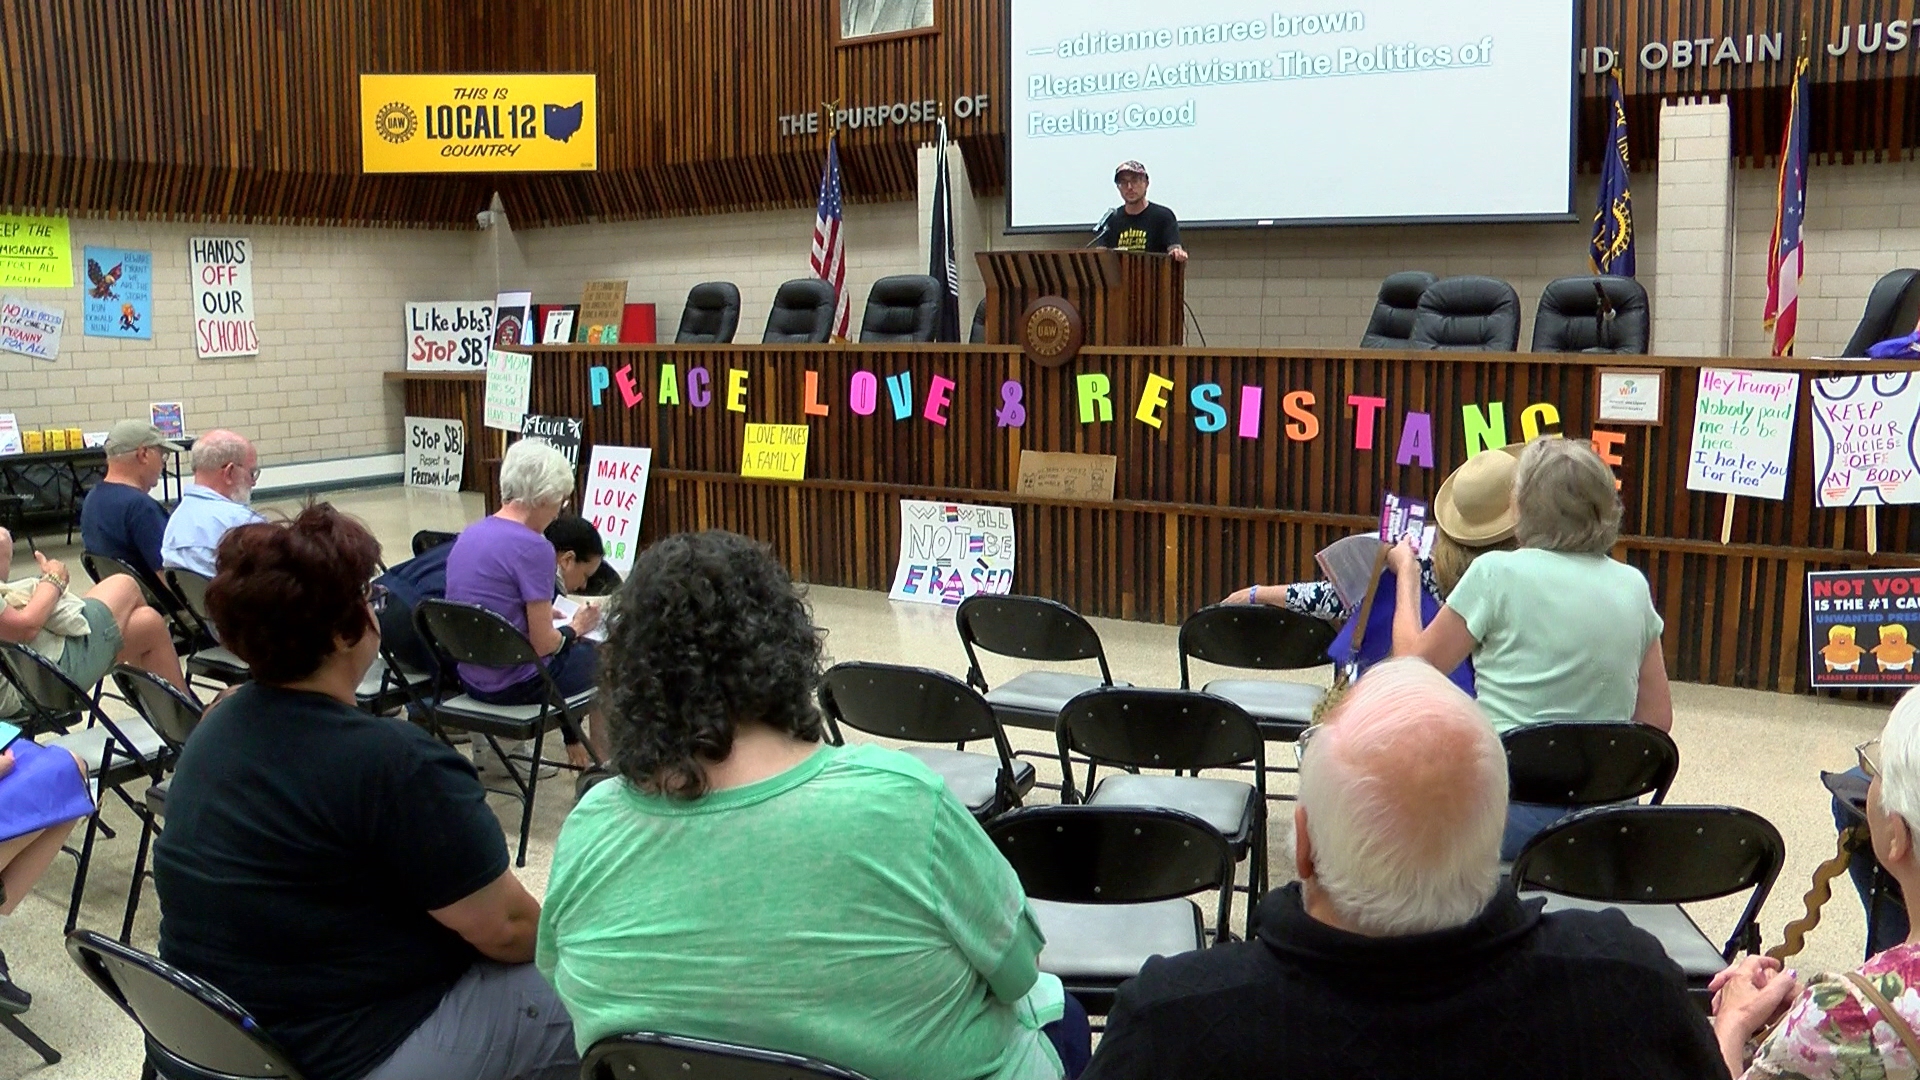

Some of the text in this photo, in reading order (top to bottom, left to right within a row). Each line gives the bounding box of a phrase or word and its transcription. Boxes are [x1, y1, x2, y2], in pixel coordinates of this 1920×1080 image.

[1058, 30, 1172, 58] adrienne
[1177, 19, 1266, 46] maree
[1272, 9, 1364, 38] brown
[1639, 32, 1783, 70] OBTAIN
[1028, 36, 1493, 98] Pleasure Activism: The Politics of
[453, 88, 508, 100] THIS IS
[387, 117, 406, 129] UAW
[426, 104, 537, 140] LOCAL 12
[779, 94, 988, 136] THE PURPOSE OF
[1028, 99, 1195, 135] Feeling Good
[440, 144, 521, 157] COUNTRY
[0, 222, 54, 238] EEP THE
[0, 244, 54, 257] MIGRANTS
[194, 239, 246, 264] HANDS
[202, 265, 238, 286] OFF
[3, 304, 21, 317] NO
[202, 290, 244, 314] OUR
[4, 316, 24, 325] FOR
[42, 323, 57, 334] IS
[412, 307, 449, 332] Like
[452, 306, 493, 332] Jobs?
[1, 325, 43, 343] TYRANNY
[198, 318, 260, 354] SCHOOLS
[1037, 326, 1058, 337] UAW
[2, 337, 48, 356] FOR ALL
[1703, 371, 1793, 402] Hey Trump!
[1700, 397, 1792, 428] Nobody paid
[1826, 401, 1883, 423] KEEP
[590, 364, 1627, 491] PEACE LOVE & RESISTANCE
[747, 426, 808, 446] LOVE MAKES
[1699, 420, 1778, 438] me to be
[1842, 420, 1904, 441] YOUR
[1836, 437, 1895, 455] POLICIES
[743, 450, 801, 472] A FAMILY
[1695, 451, 1707, 464] I
[1714, 451, 1757, 470] hate
[1849, 452, 1881, 468] OFF
[597, 460, 642, 483] MAKE
[1702, 465, 1759, 486] for free
[1827, 467, 1913, 488] MY BODY
[594, 488, 638, 511] LOVE
[592, 514, 630, 537] NOT
[957, 508, 1009, 529] WILL
[603, 540, 627, 560] AR
[908, 523, 1013, 560] NOT BE
[902, 565, 1013, 597] ERASED
[1813, 577, 1920, 597] NOT VOT
[1814, 599, 1830, 611] IS
[1834, 598, 1864, 611] THE
[1868, 597, 1889, 609] #1
[1816, 612, 1920, 624] UNWANTED PRES
